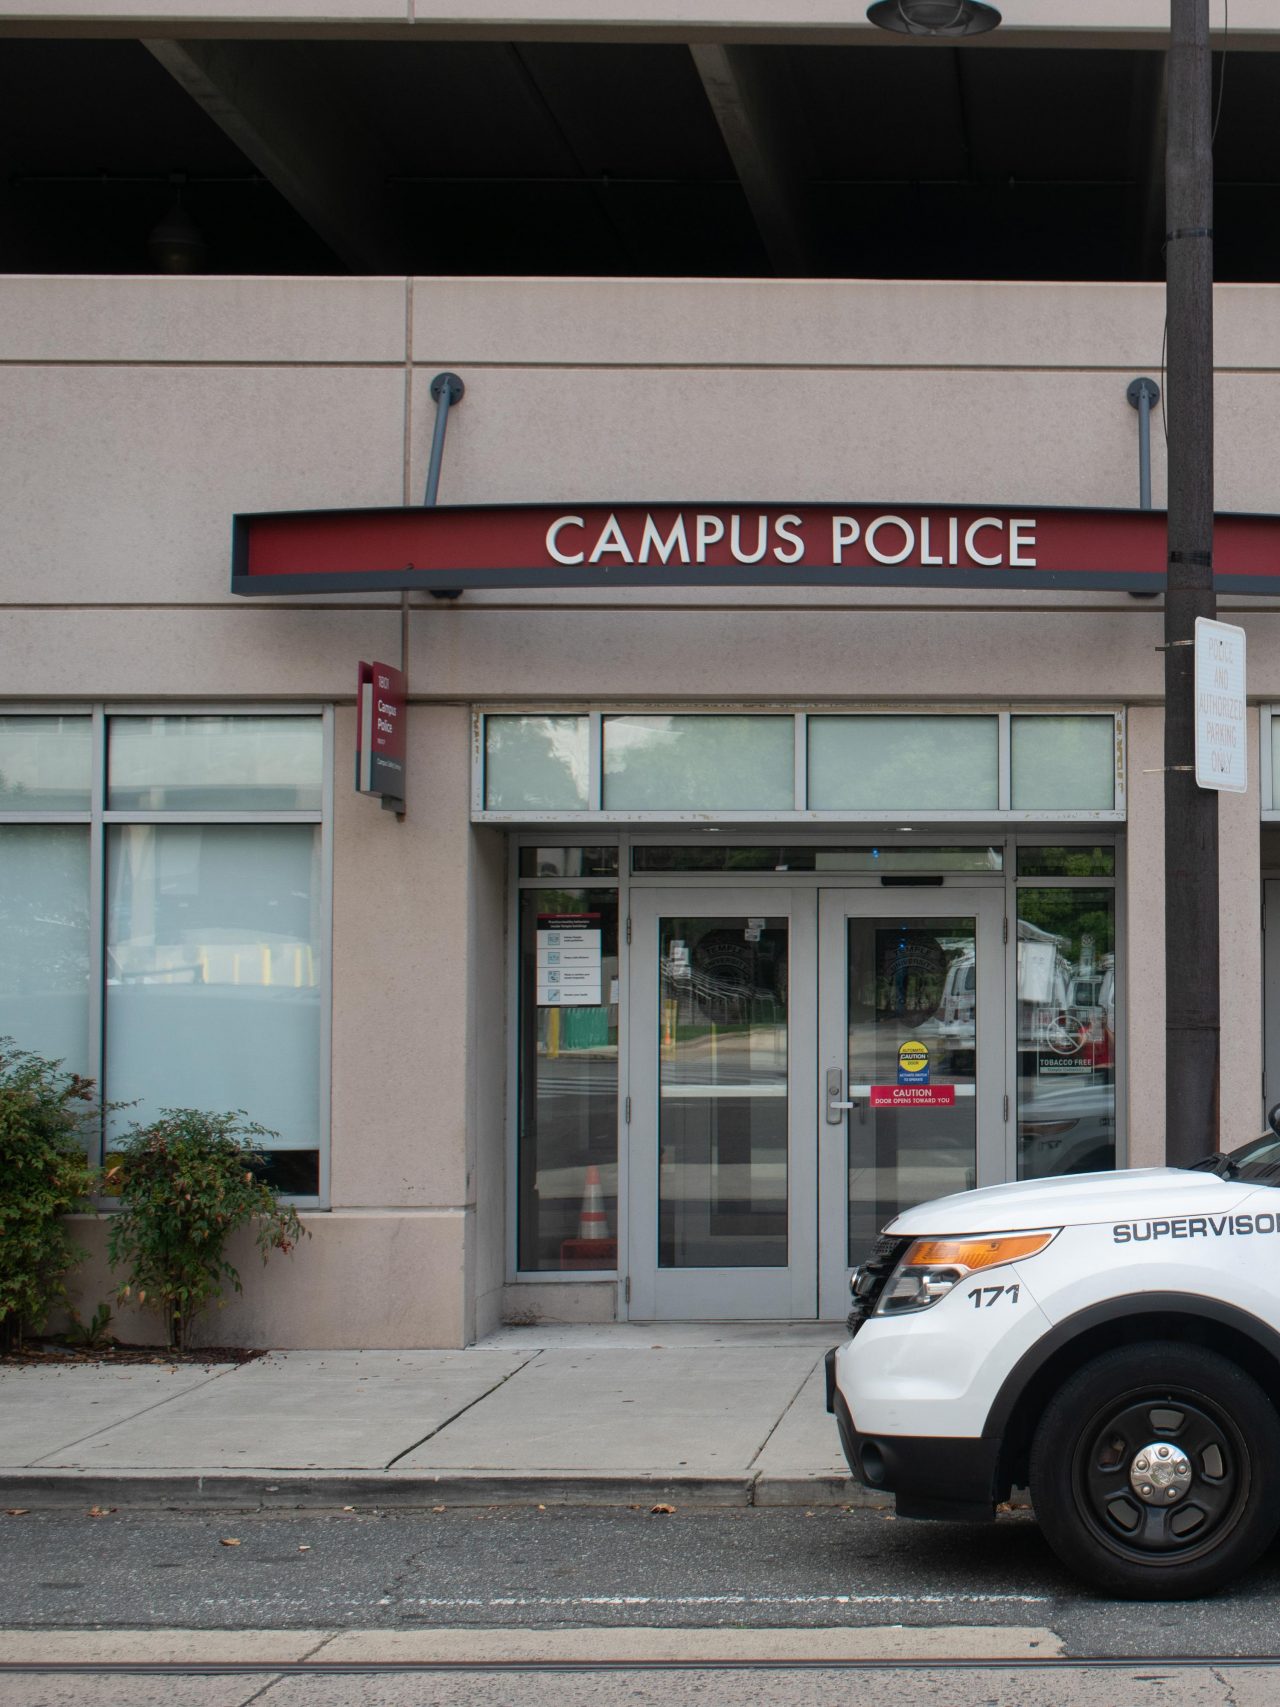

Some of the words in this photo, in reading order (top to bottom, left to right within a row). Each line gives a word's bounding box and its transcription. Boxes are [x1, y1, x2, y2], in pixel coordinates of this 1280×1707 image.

[545, 513, 805, 566] CAMPUS
[832, 515, 1037, 567] POLICE
[1208, 637, 1233, 664] POLICE
[1214, 667, 1229, 690] AND
[377, 700, 397, 717] Campus
[1199, 695, 1243, 721] AUTHORIZED
[377, 718, 393, 734] Police
[1206, 721, 1237, 748] PARKING
[1211, 750, 1232, 774] ONLY
[893, 1089, 932, 1097] CAUTION
[967, 1284, 1021, 1309] 171
